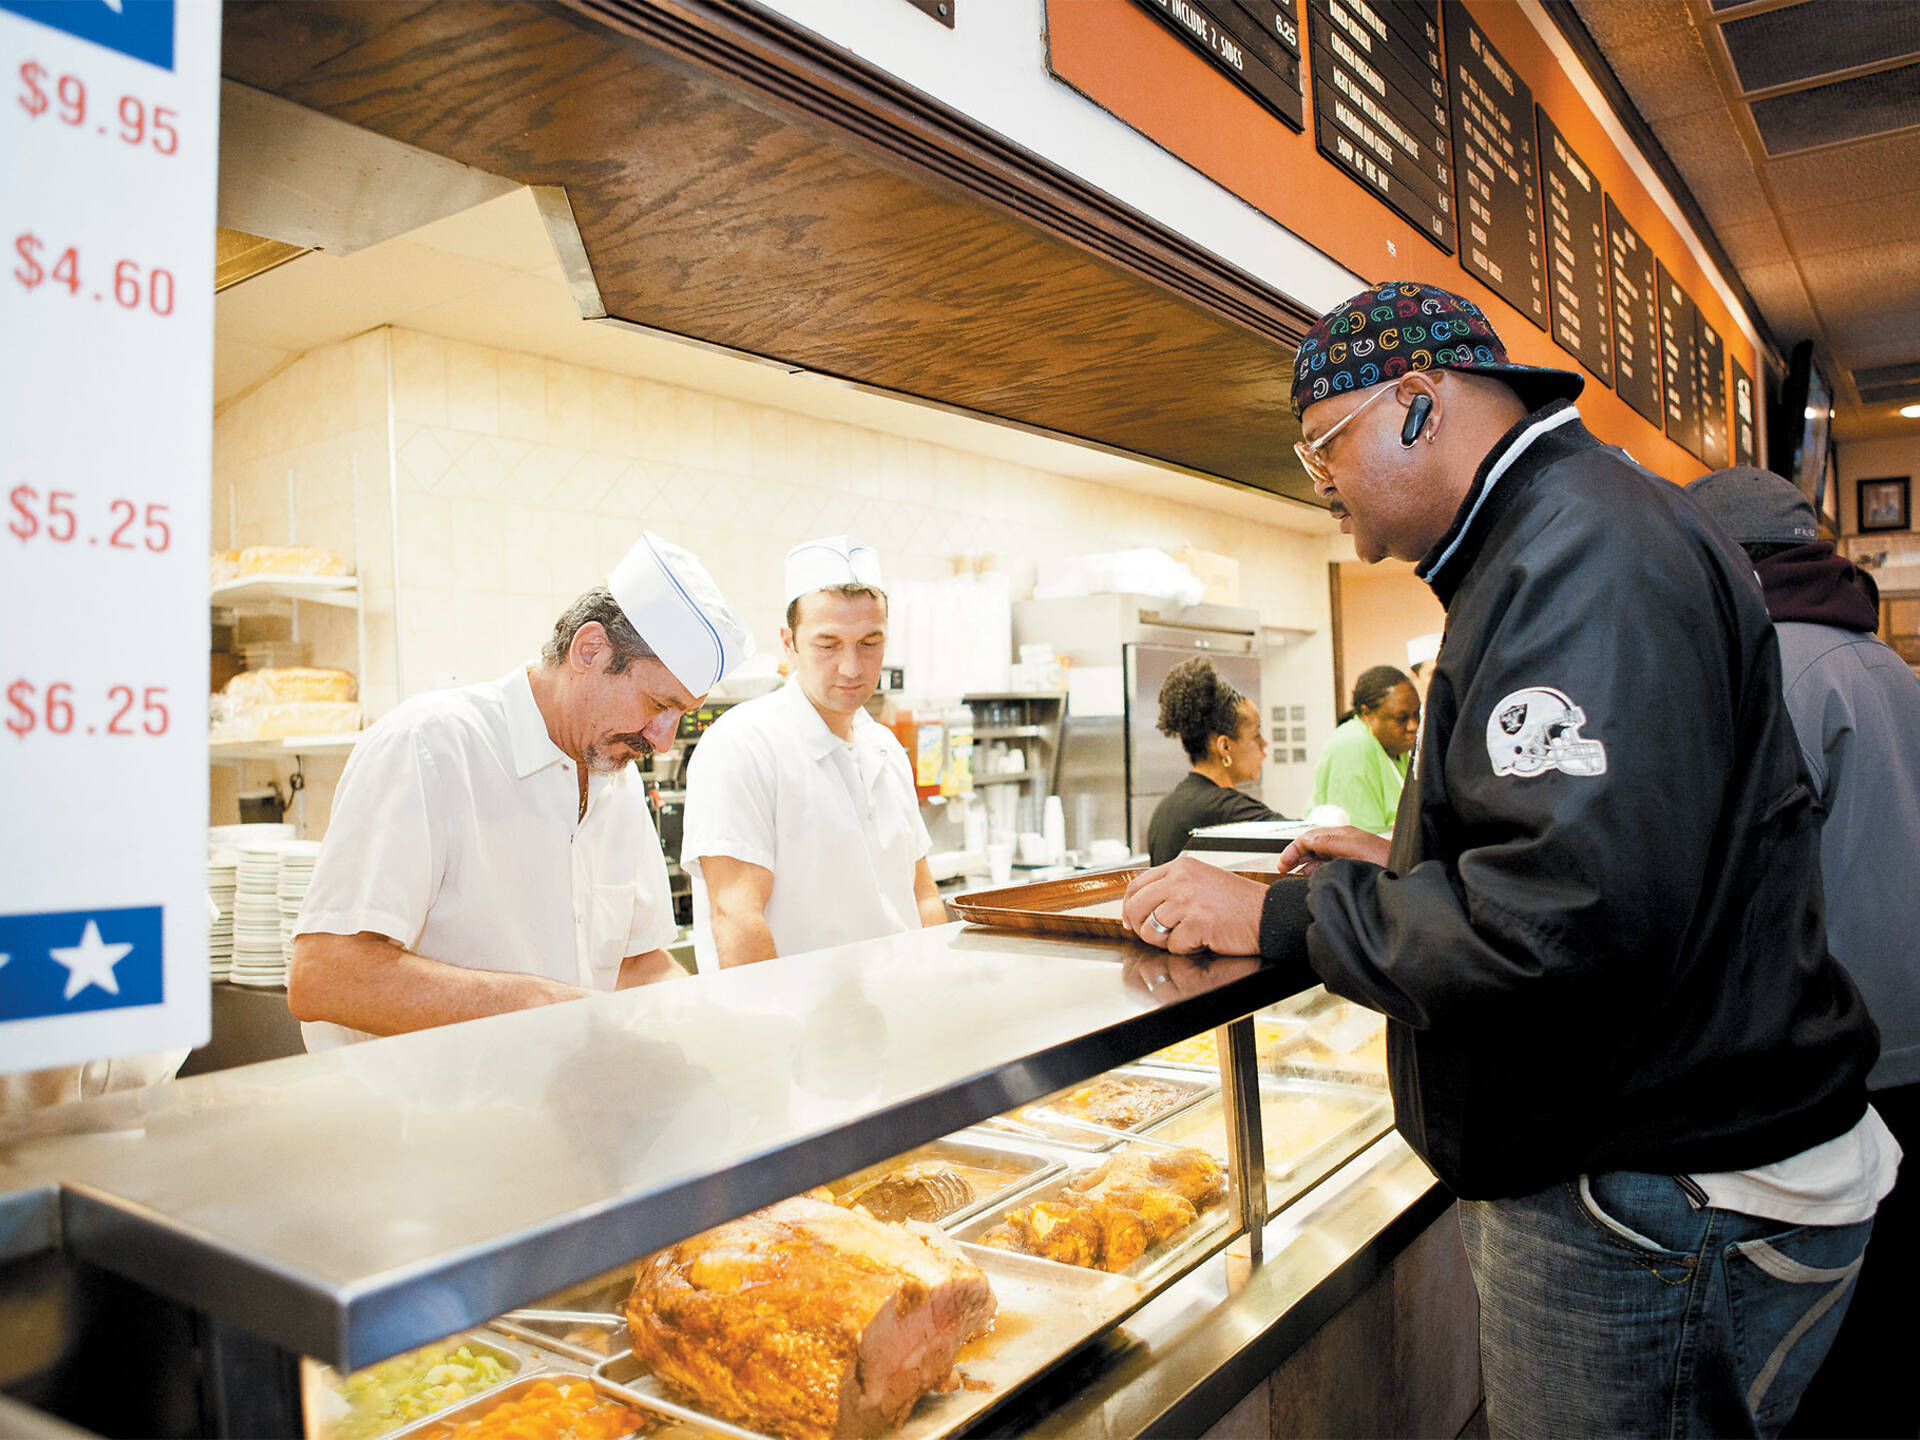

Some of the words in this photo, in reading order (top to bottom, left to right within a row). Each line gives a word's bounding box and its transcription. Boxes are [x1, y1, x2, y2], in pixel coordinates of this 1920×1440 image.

[1171, 0, 1207, 42] INCLUDE
[1211, 27, 1217, 49] 2
[1220, 36, 1243, 70] SIDES
[1275, 14, 1297, 47] 6.25
[18, 60, 179, 156] $9.95
[14, 230, 175, 317] $4.60
[8, 484, 172, 552] $5.25
[6, 678, 170, 740] $6.25
